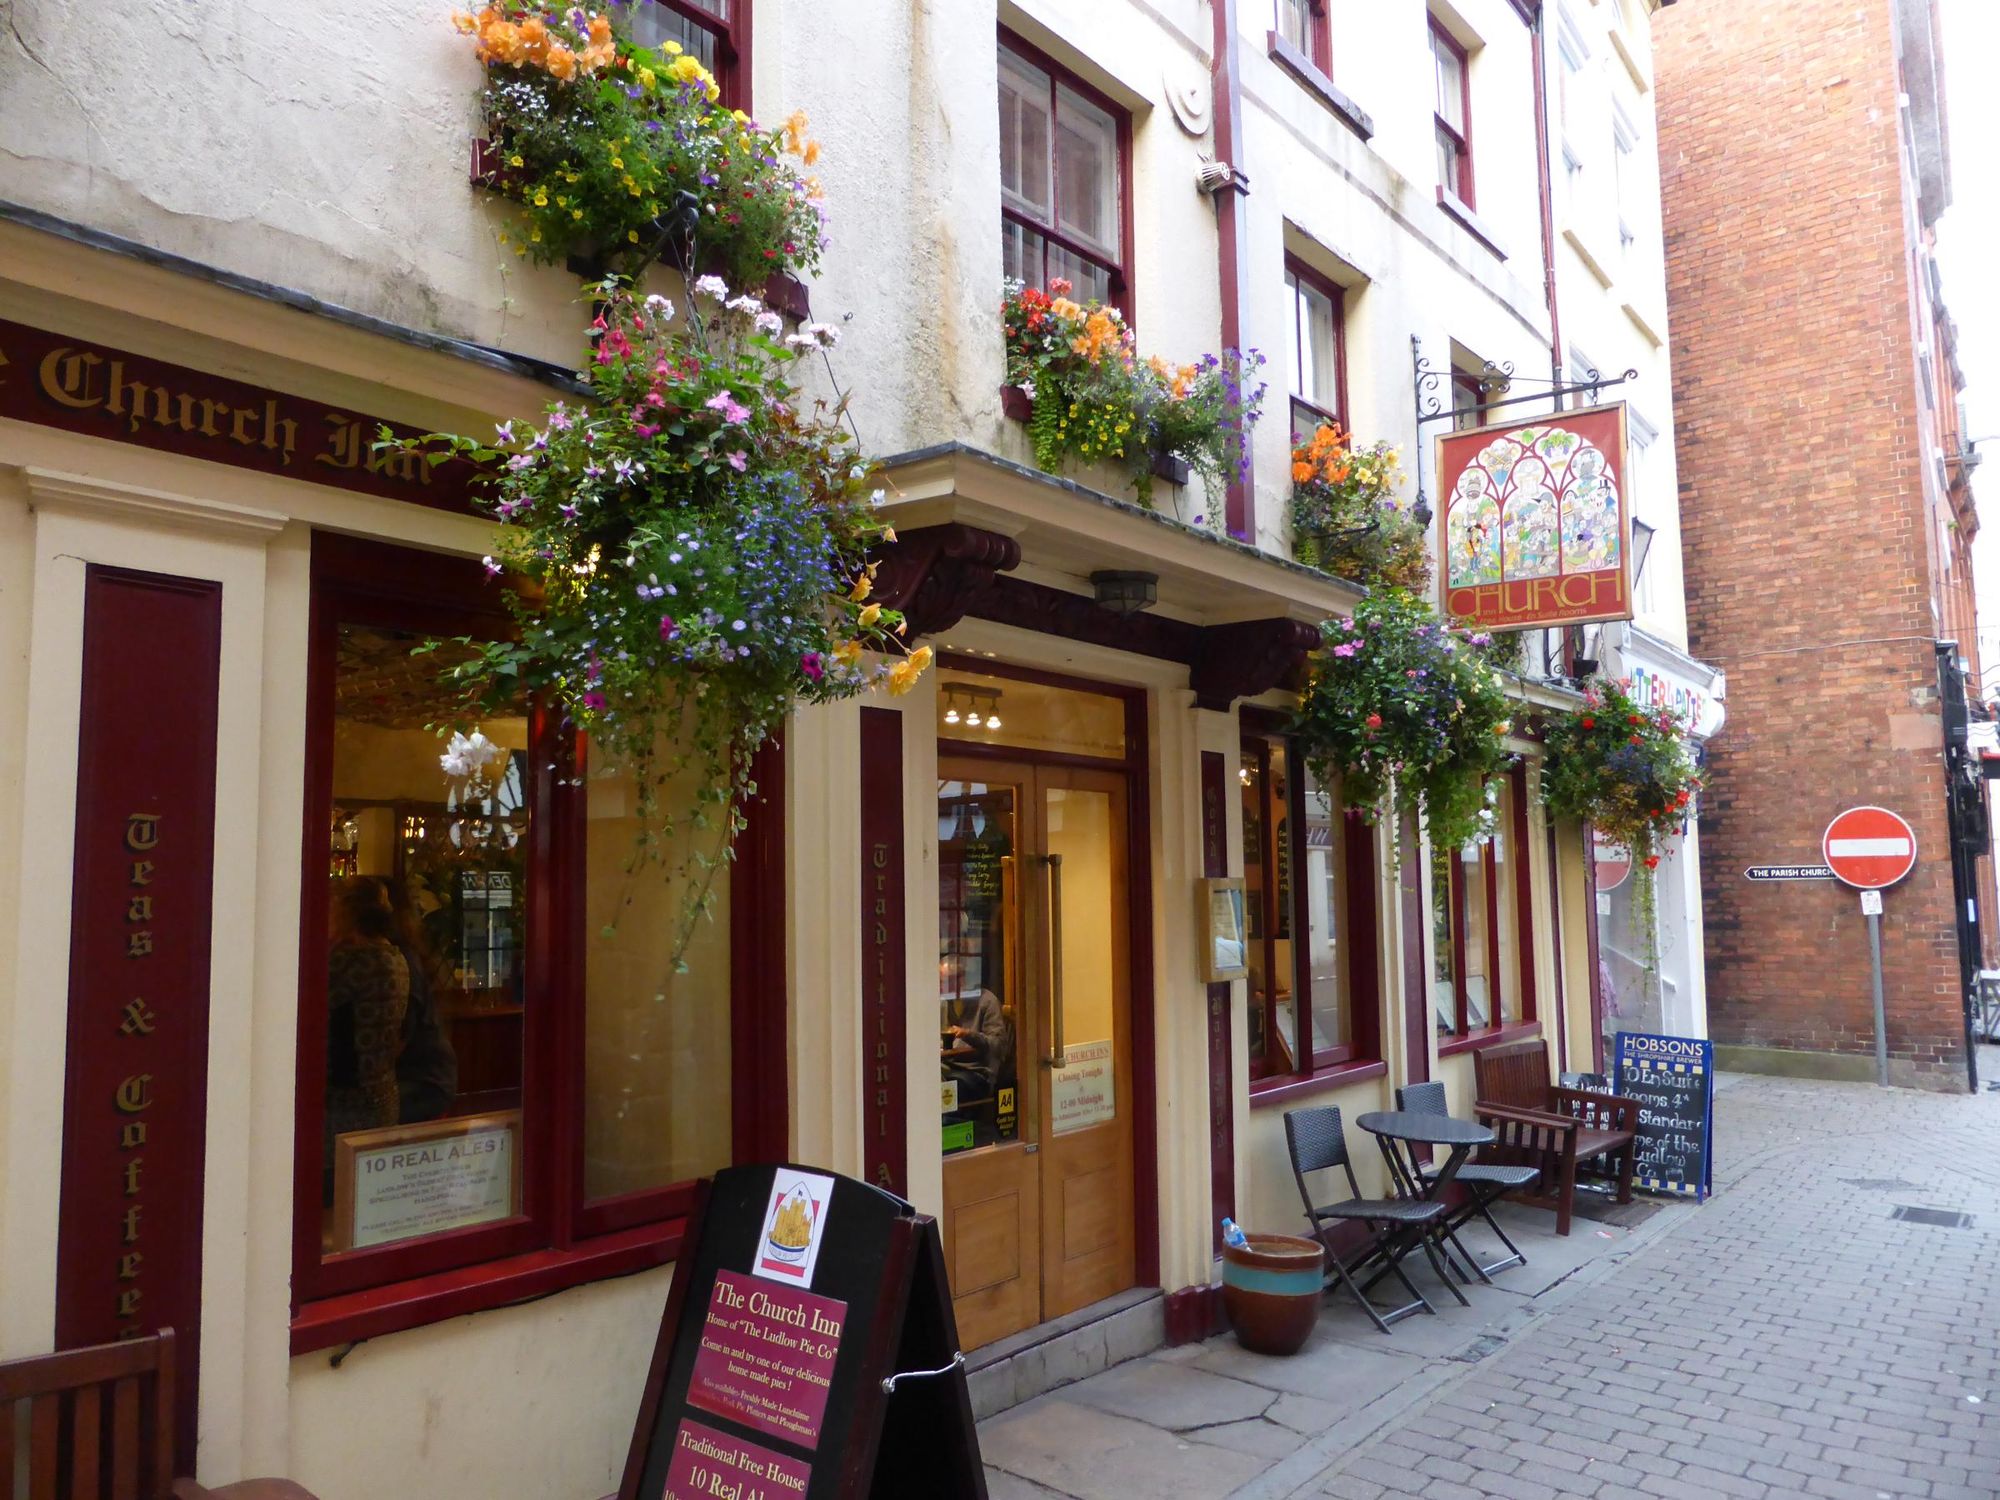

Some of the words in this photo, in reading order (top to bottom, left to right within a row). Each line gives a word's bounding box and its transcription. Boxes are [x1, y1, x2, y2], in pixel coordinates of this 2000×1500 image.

[40, 347, 299, 466] Church
[315, 413, 432, 485] Inn
[1448, 570, 1622, 618] CHURCH
[126, 812, 162, 957] Teas
[1753, 869, 1769, 877] THE
[1770, 869, 1799, 877] PARISH
[1800, 868, 1834, 877] CHURCH
[873, 843, 889, 1137] Traditional
[120, 997, 156, 1034] &
[1624, 1036, 1704, 1056] HOBSONS
[1637, 1052, 1675, 1062] SHROPSHIRE
[1676, 1056, 1703, 1065] BREWER
[1623, 1066, 1640, 1082] 10
[1641, 1068, 1660, 1088] En
[1000, 1093, 1012, 1108] AA
[366, 1157, 386, 1173] 10
[392, 1149, 443, 1169] REAL
[448, 1139, 496, 1160] ALES
[1674, 1134, 1700, 1153] the
[714, 1281, 745, 1309] The
[749, 1291, 806, 1327] Church
[810, 1309, 841, 1338] Inn
[706, 1312, 728, 1328] Home
[729, 1318, 739, 1330] of
[762, 1327, 798, 1348] Ludlow
[800, 1338, 815, 1355] Pie
[701, 1336, 722, 1351] Come
[723, 1342, 731, 1354] in
[731, 1346, 746, 1360] and
[745, 1350, 755, 1364] try
[756, 1356, 771, 1368] one
[771, 1360, 782, 1372] of
[782, 1364, 795, 1376] our
[796, 1367, 831, 1388] delicious
[728, 1361, 748, 1377] home
[749, 1368, 770, 1384] made
[770, 1376, 787, 1390] pies
[762, 1397, 778, 1410] Made
[778, 1402, 810, 1422] Lunchtime
[767, 1412, 778, 1424] and
[778, 1416, 817, 1437] Ploughman's
[680, 1430, 737, 1466] Traditional
[738, 1451, 764, 1476] Free
[766, 1462, 806, 1492] House
[688, 1465, 707, 1489] 10
[708, 1472, 742, 1500] Real
